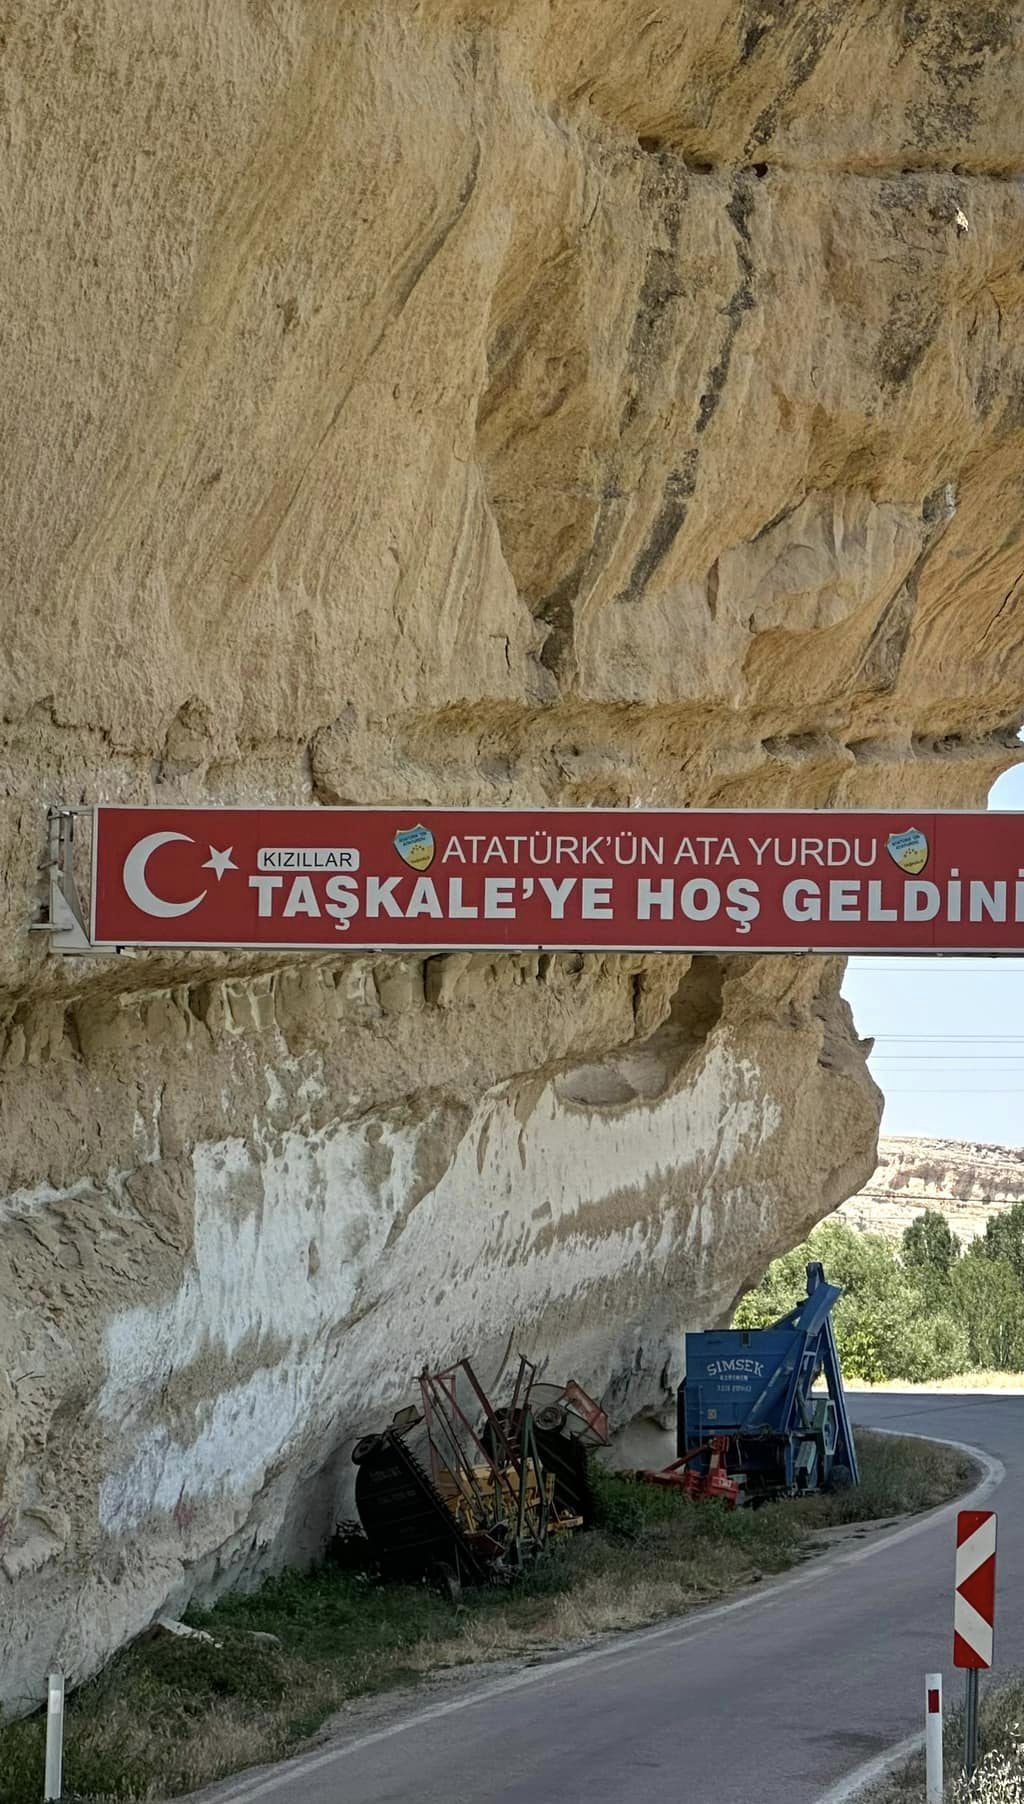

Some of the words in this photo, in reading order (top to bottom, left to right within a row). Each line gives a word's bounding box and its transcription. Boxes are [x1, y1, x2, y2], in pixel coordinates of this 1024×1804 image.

[263, 852, 354, 868] KIZILLAR
[441, 831, 664, 865] ATATÜRK'ÜN
[674, 837, 741, 866] ATA
[749, 837, 877, 866] YURDU
[249, 875, 613, 931] TAŞKALE'YE
[637, 877, 761, 933] HOŞ
